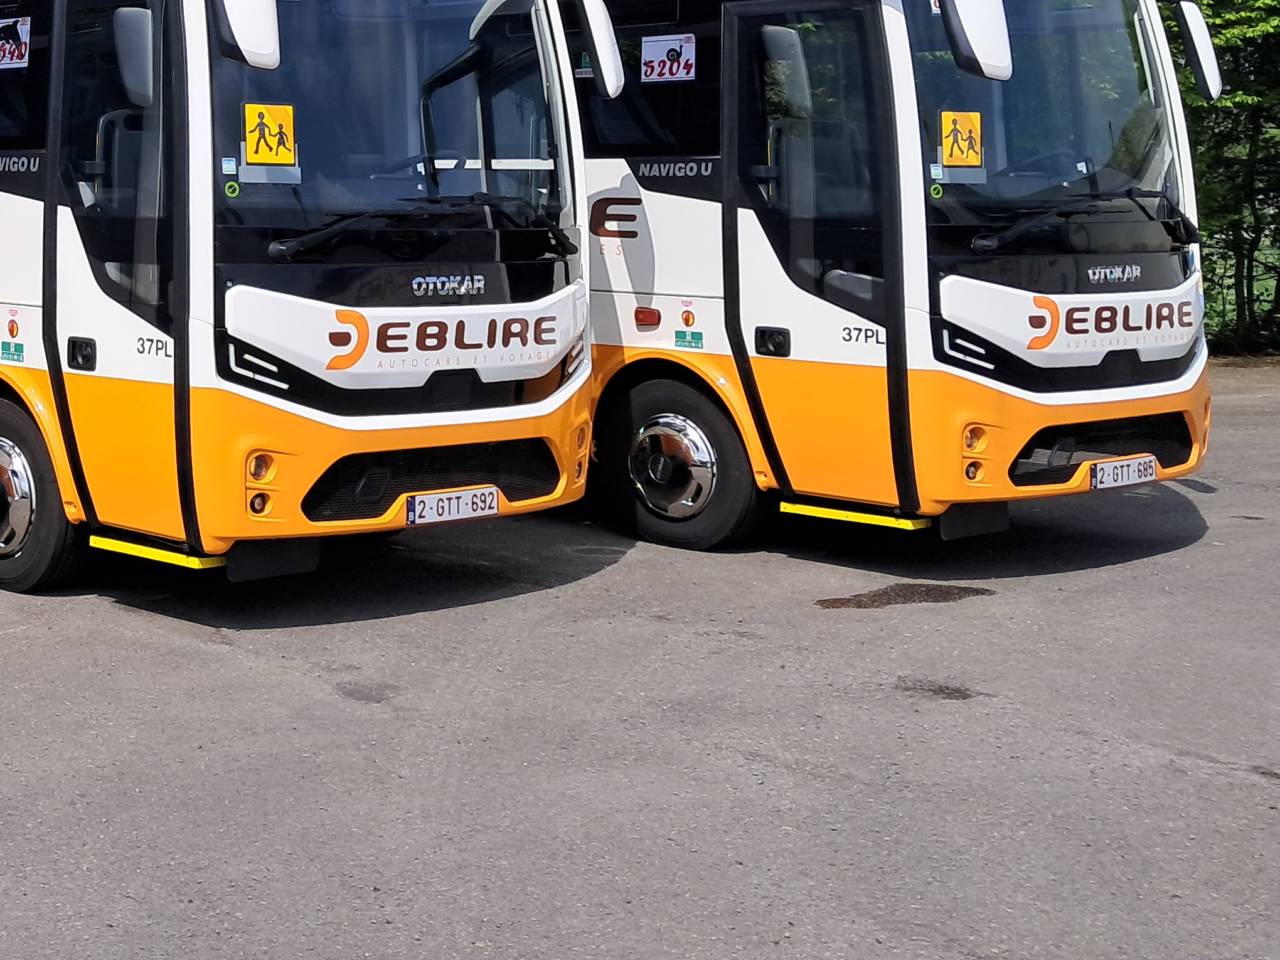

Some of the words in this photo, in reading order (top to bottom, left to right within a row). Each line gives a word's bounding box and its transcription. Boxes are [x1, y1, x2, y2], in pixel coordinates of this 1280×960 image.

[643, 58, 694, 77] 5204
[29, 157, 40, 172] U
[638, 162, 698, 176] NAVIGO
[701, 162, 713, 176] U
[1088, 264, 1143, 284] OTOKAR
[412, 275, 485, 297] OTOKAR
[1026, 295, 1193, 350] DEBLIRE
[325, 309, 557, 370] DEBLIRE
[842, 327, 886, 345] 37PL
[1066, 337, 1128, 348] AUTOCARS
[136, 337, 173, 358] 37PL
[377, 355, 461, 369] AUTOCARS
[473, 354, 488, 364] ET
[500, 350, 556, 362] VOYAGE
[418, 491, 495, 519] 2-GTT-692
